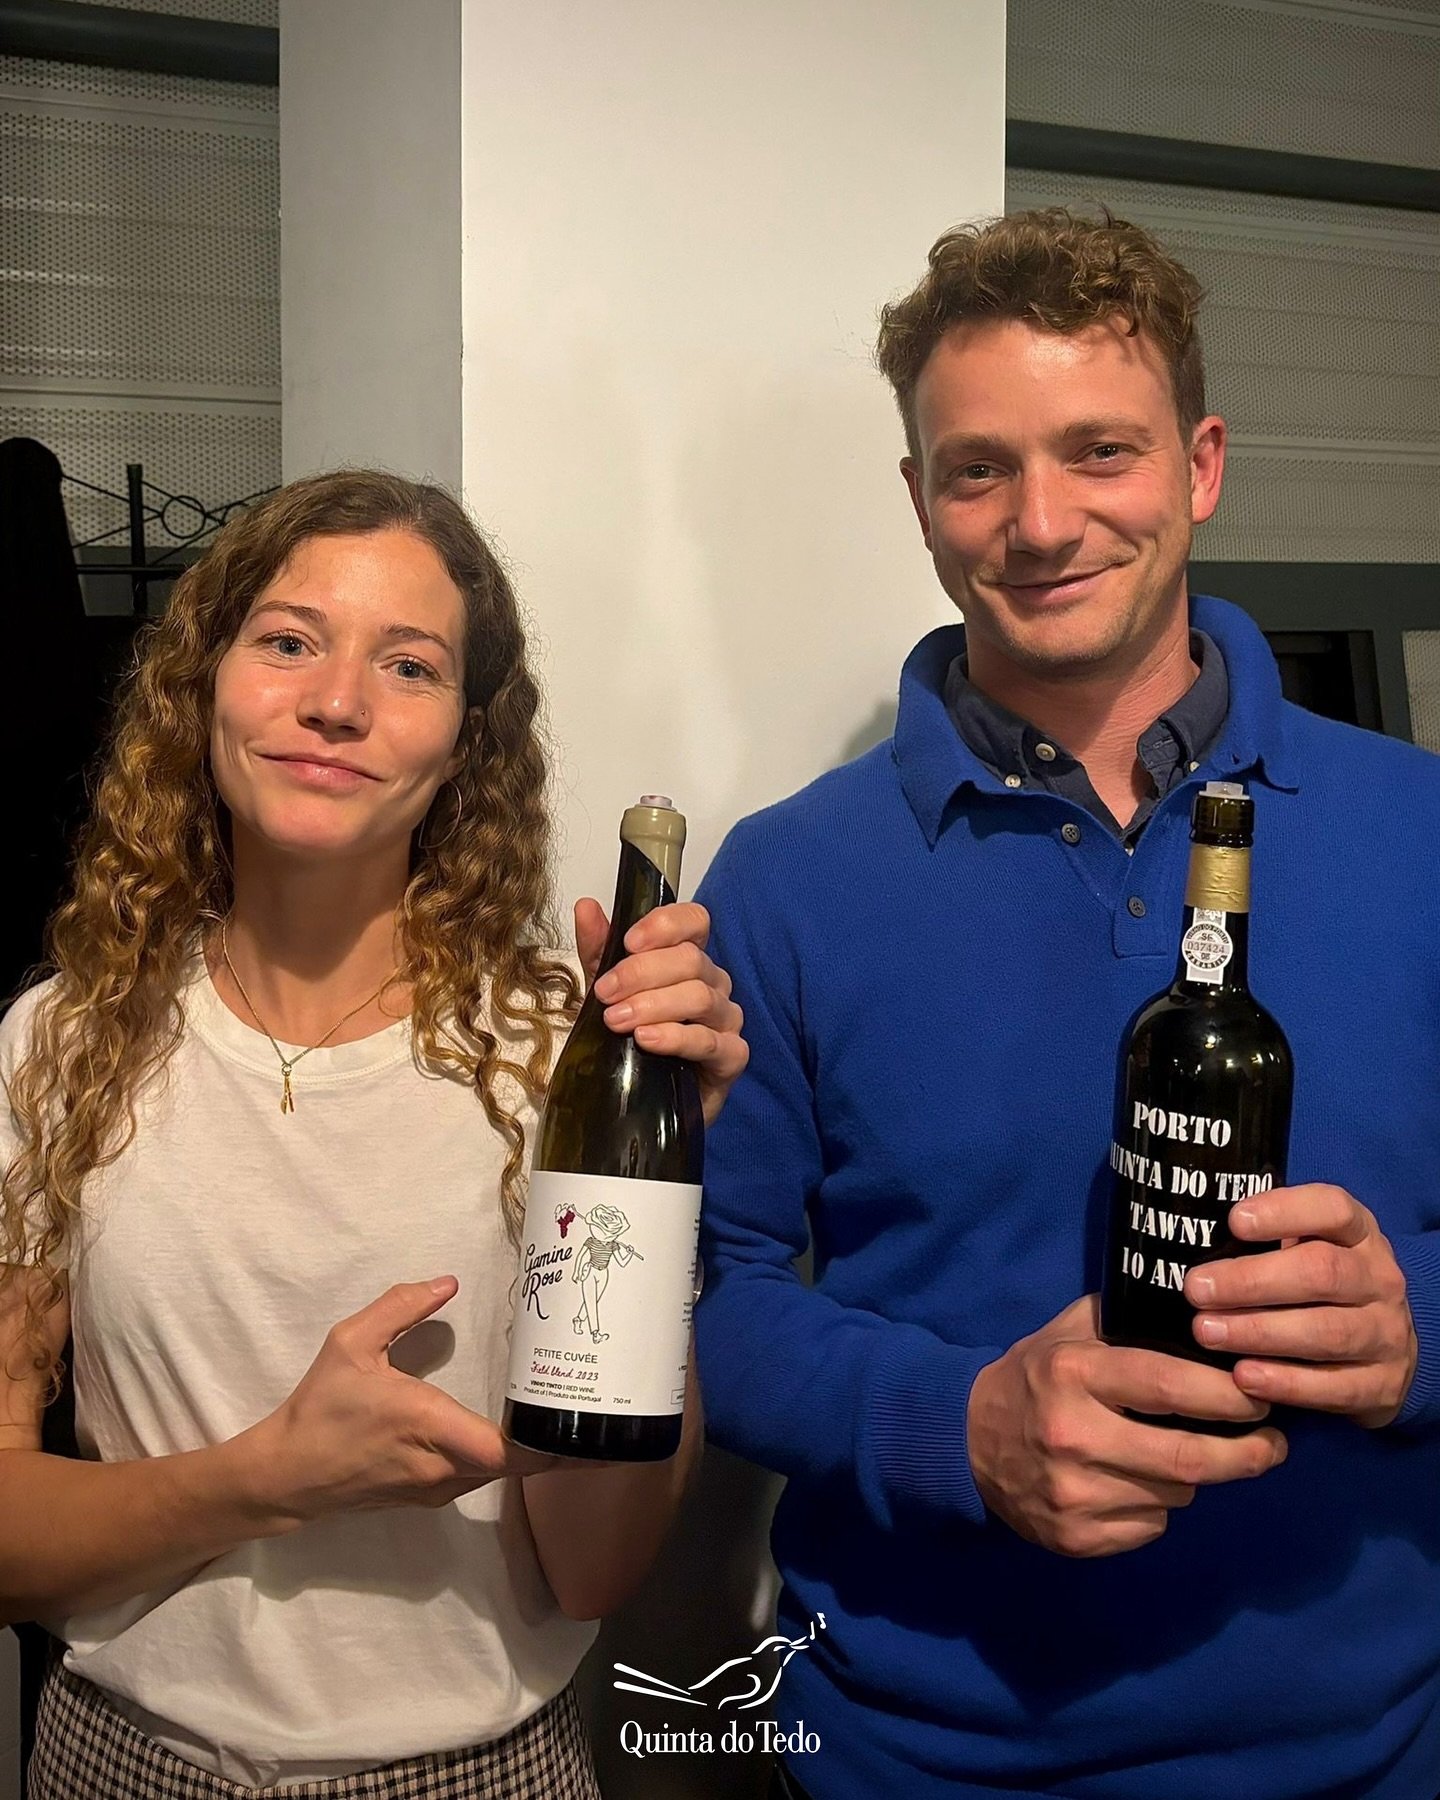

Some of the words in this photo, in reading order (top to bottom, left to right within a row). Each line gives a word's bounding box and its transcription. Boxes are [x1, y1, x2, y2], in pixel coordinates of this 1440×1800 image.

[1187, 941, 1225, 953] 037424
[1133, 1101, 1232, 1148] PORTO
[1110, 1139, 1163, 1190] UINTA
[1171, 1166, 1208, 1198] DO
[1215, 1172, 1273, 1202] TEDO
[1130, 1201, 1217, 1247] TAWNY
[522, 1243, 573, 1298] Gamine
[1122, 1247, 1145, 1279] 10
[527, 1269, 563, 1320] Rose
[534, 1347, 562, 1360] PETITE
[564, 1351, 598, 1364] CUVÉE
[530, 1380, 546, 1388] VINHO
[546, 1382, 562, 1390] TINTO
[579, 1386, 595, 1394] WINE
[575, 1370, 599, 1381] 2023
[612, 1397, 624, 1405] 750
